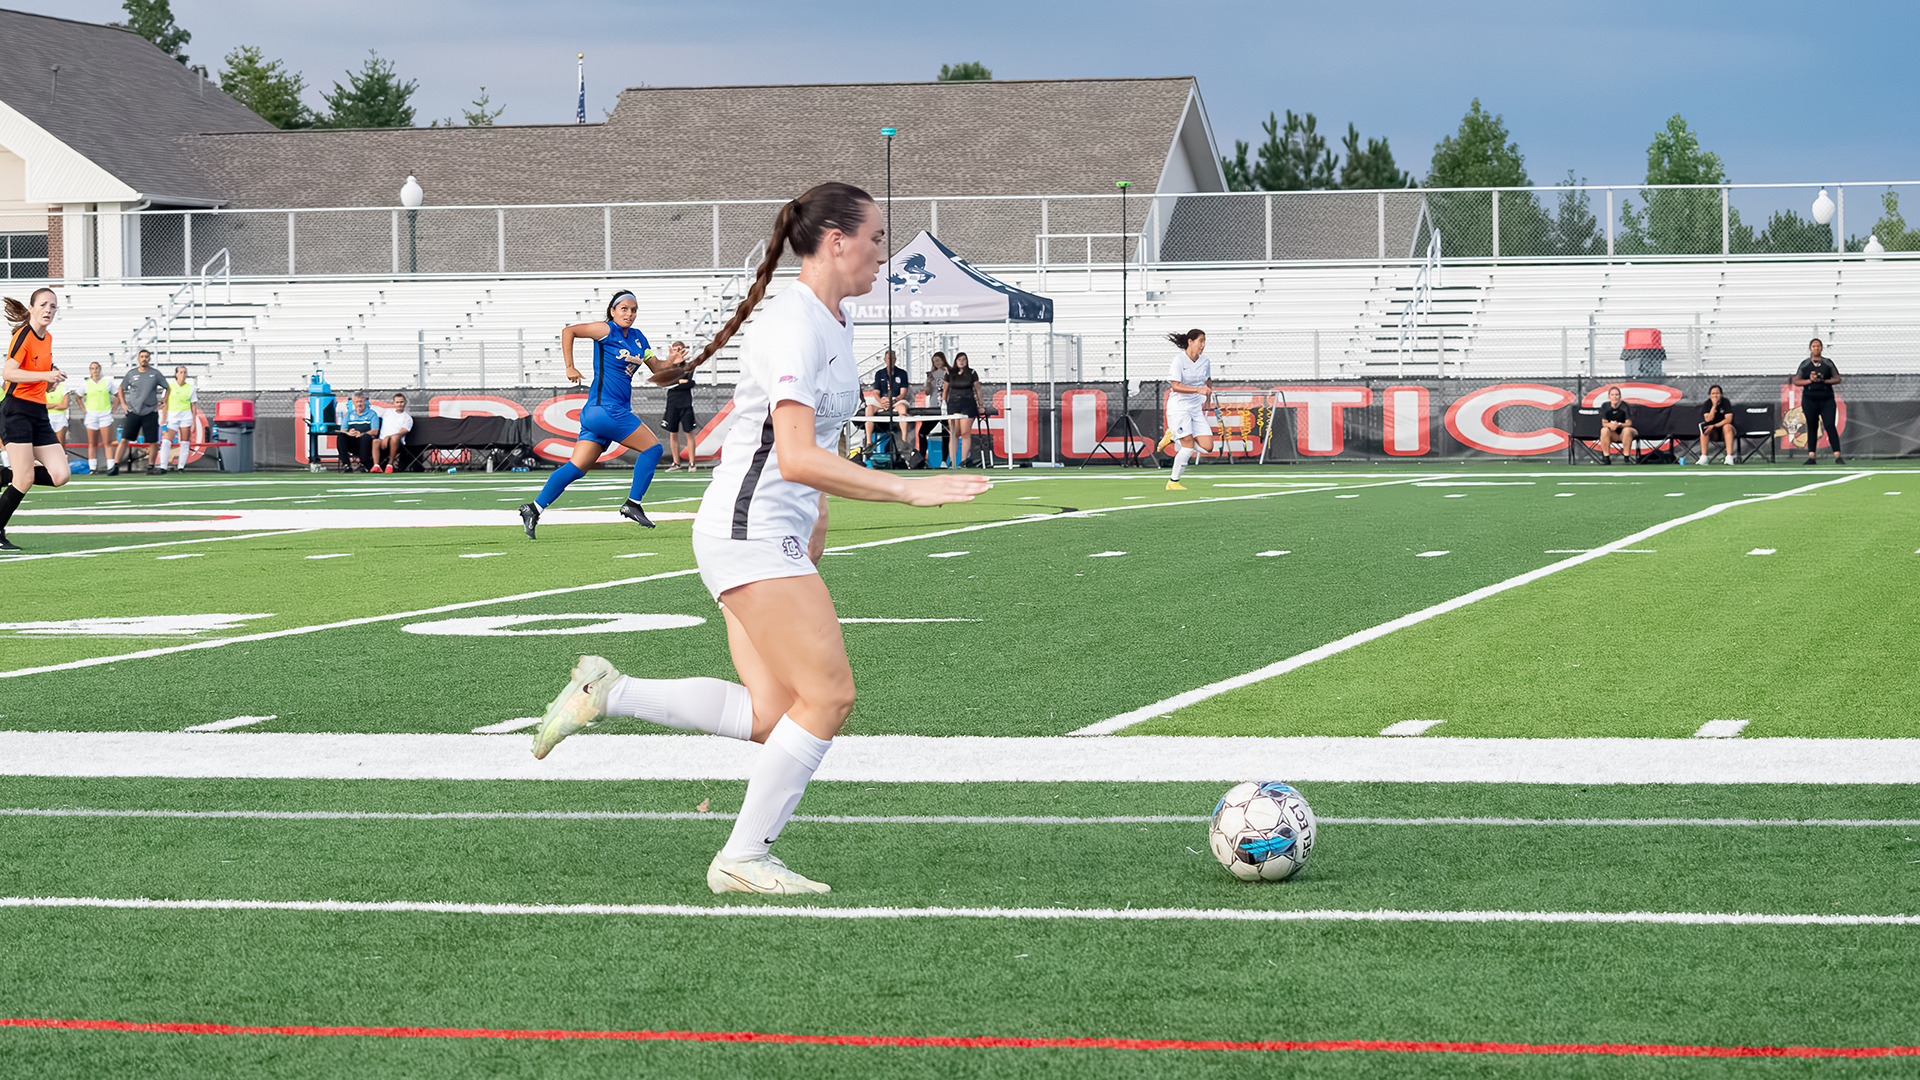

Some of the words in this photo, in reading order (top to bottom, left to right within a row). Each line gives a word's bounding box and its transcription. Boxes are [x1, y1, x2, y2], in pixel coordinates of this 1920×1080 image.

[845, 301, 906, 319] DALTON
[909, 300, 960, 318] STATE
[680, 382, 1684, 461] HLETICS
[1288, 802, 1313, 860] SELECT
